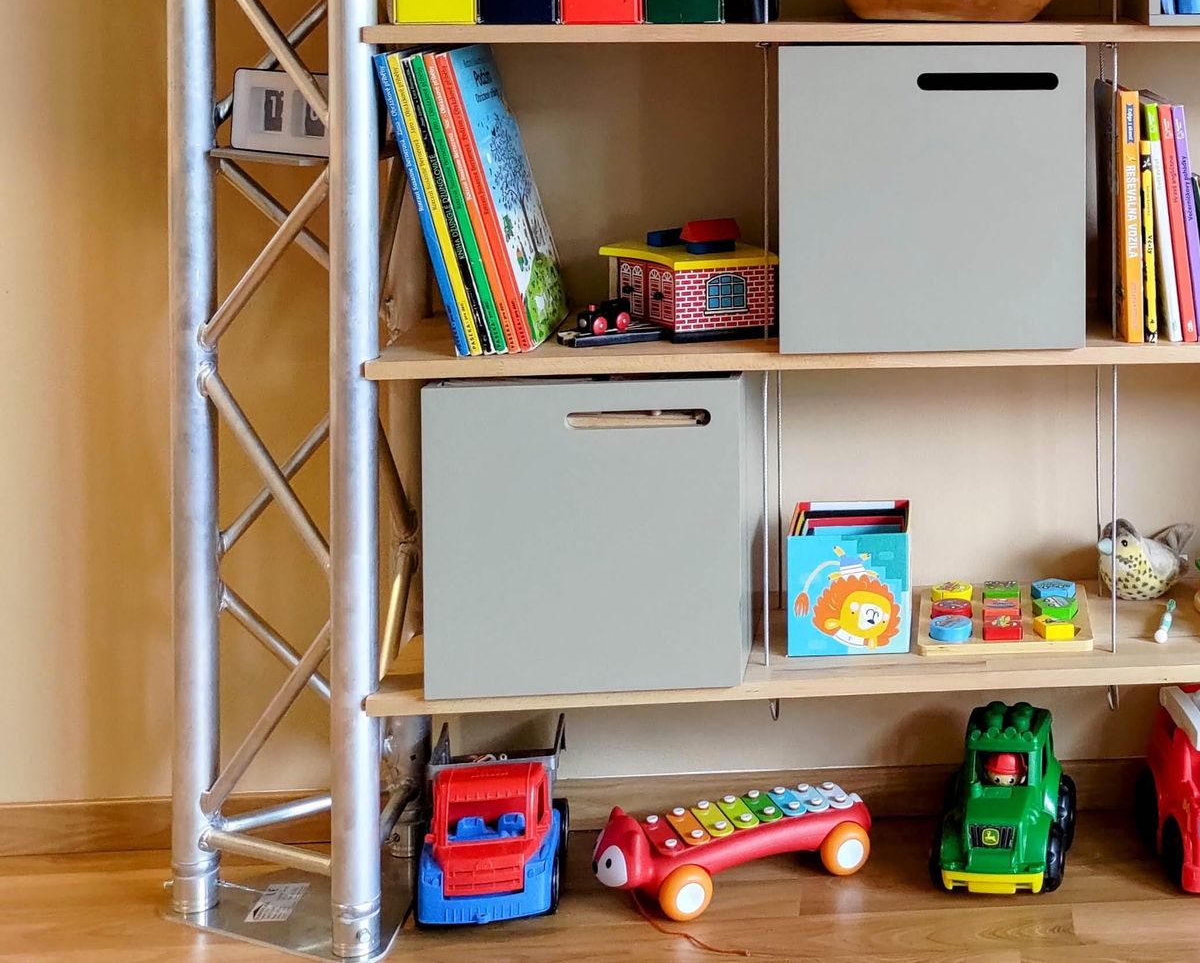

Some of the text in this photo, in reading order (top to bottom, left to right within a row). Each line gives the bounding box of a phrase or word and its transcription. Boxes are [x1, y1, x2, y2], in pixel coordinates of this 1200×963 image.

[441, 203, 458, 238] DŽUNGLE
[452, 238, 464, 260] KNIHA
[1127, 224, 1140, 258] VOZILA
